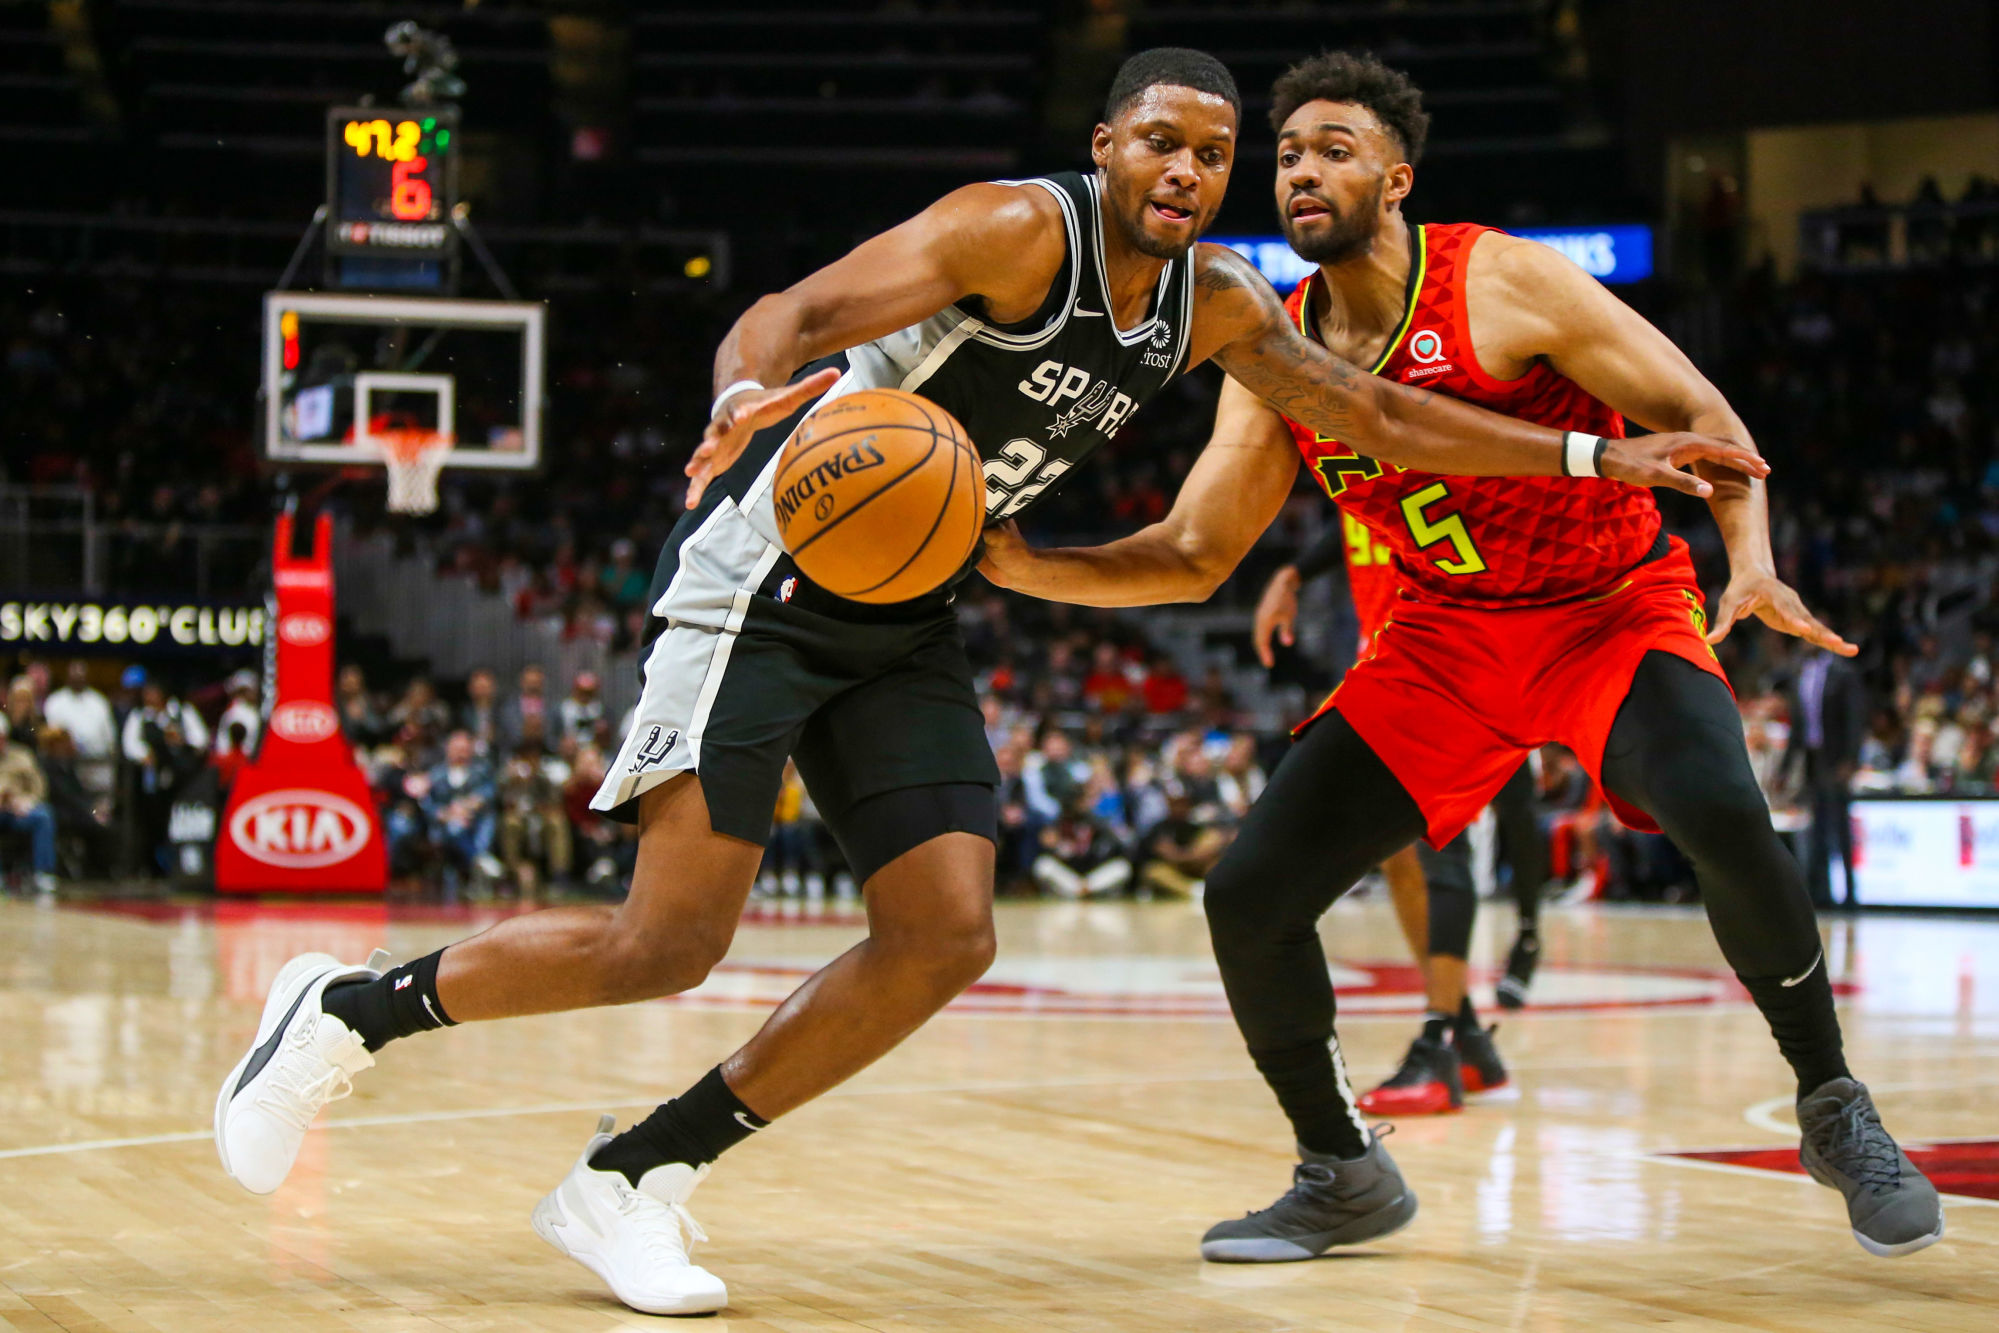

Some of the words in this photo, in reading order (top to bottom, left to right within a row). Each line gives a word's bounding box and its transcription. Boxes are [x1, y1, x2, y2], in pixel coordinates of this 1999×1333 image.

[391, 156, 432, 221] 6
[1408, 364, 1453, 378] sharecare
[1399, 479, 1489, 575] 5
[254, 807, 350, 852] KIA
